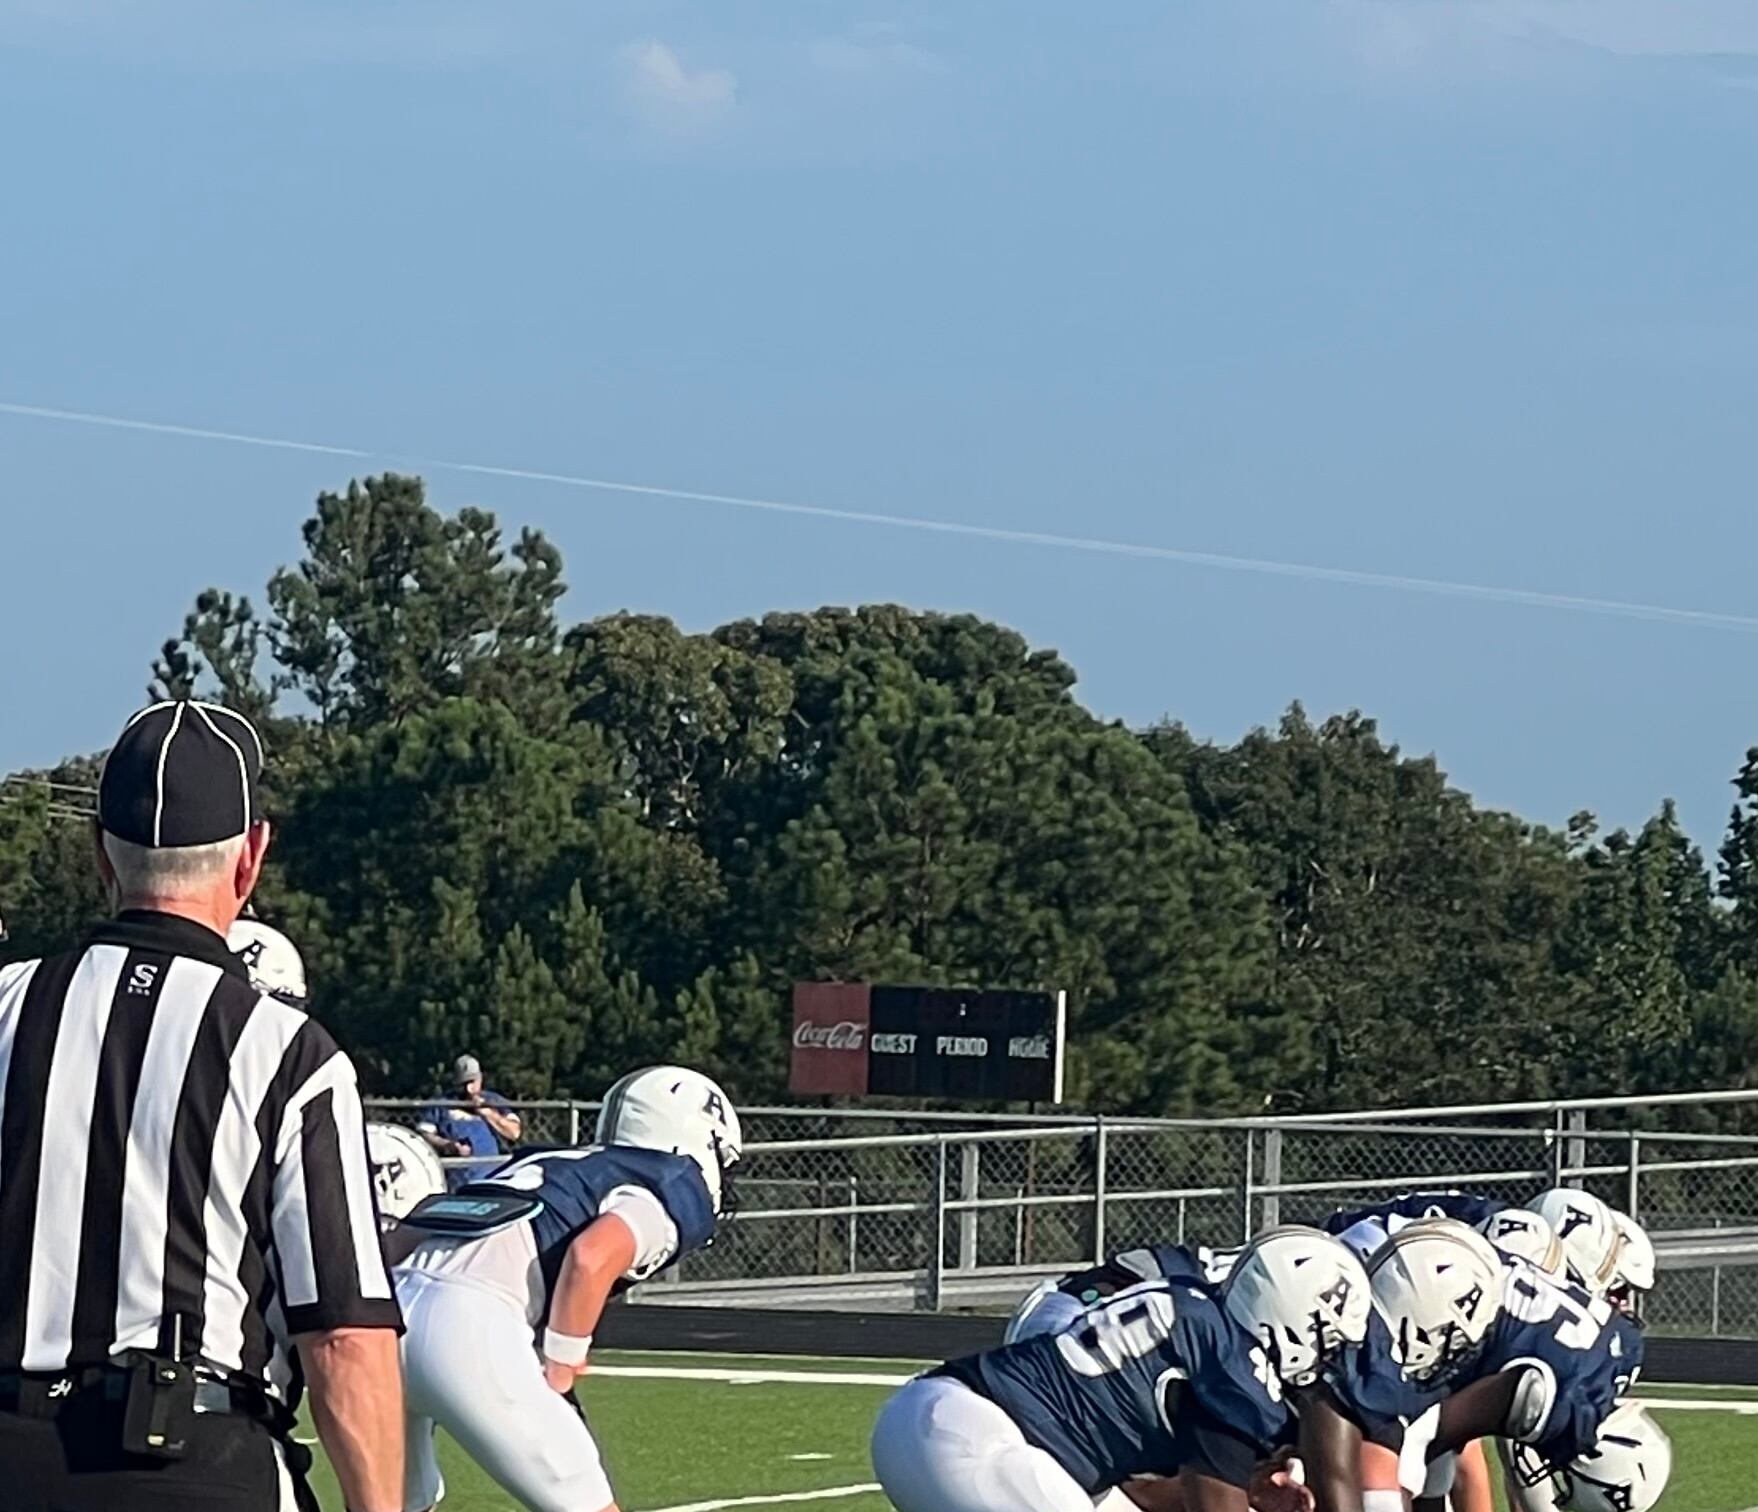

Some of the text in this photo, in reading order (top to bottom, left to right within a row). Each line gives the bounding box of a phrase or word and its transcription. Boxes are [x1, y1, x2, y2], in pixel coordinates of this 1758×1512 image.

[1499, 1219, 1527, 1235] A
[1559, 1204, 1592, 1238] A
[1454, 1282, 1484, 1321] A
